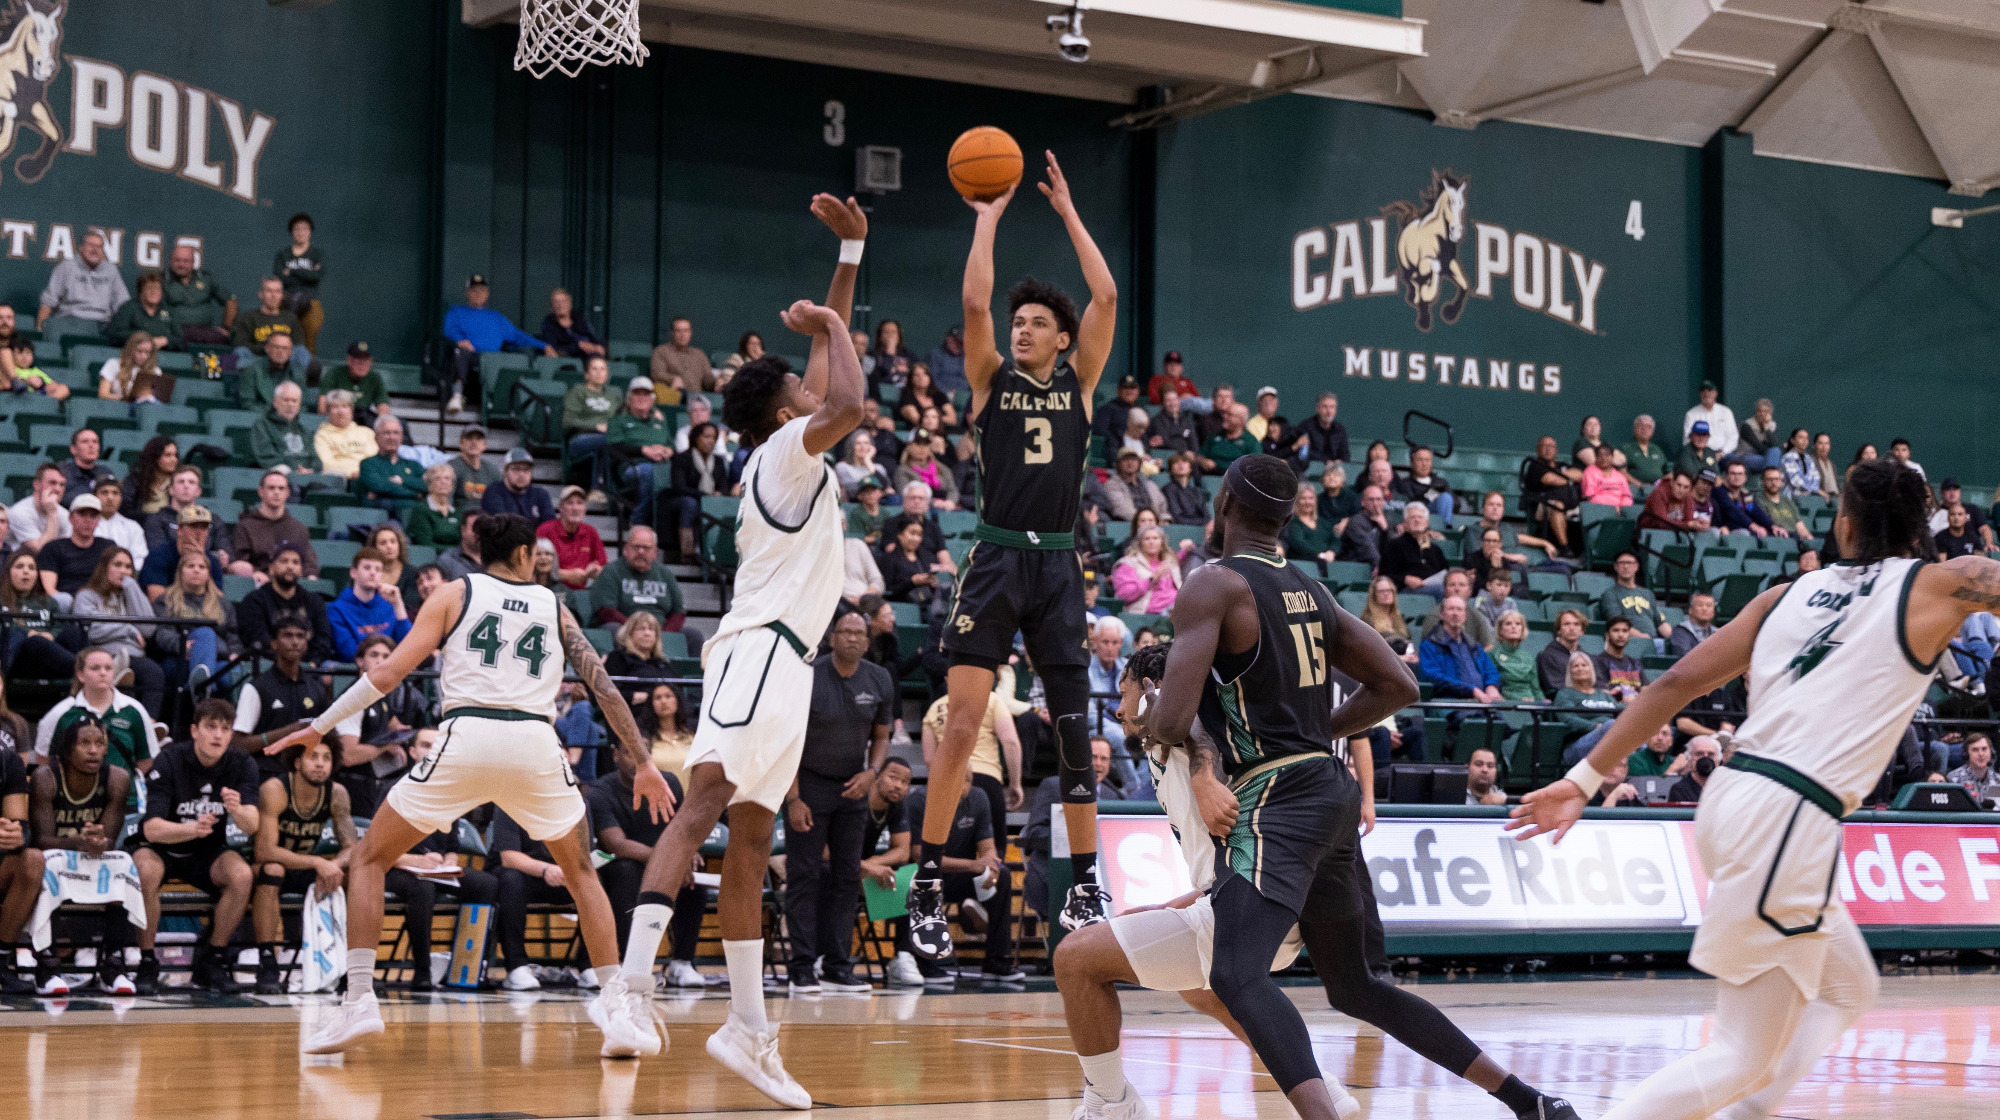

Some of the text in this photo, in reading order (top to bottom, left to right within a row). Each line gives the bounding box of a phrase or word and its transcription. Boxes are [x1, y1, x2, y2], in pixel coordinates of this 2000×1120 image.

[66, 56, 275, 204] POLY
[822, 99, 846, 147] 3
[1625, 200, 1645, 241] 4
[1292, 217, 1606, 334] CAL POLY
[1342, 345, 1562, 393] MUSTANGS
[1024, 417, 1053, 464] 3
[466, 611, 551, 679] 44
[1289, 621, 1326, 687] 15
[1366, 828, 1491, 907] afe
[1497, 829, 1666, 906] Ride
